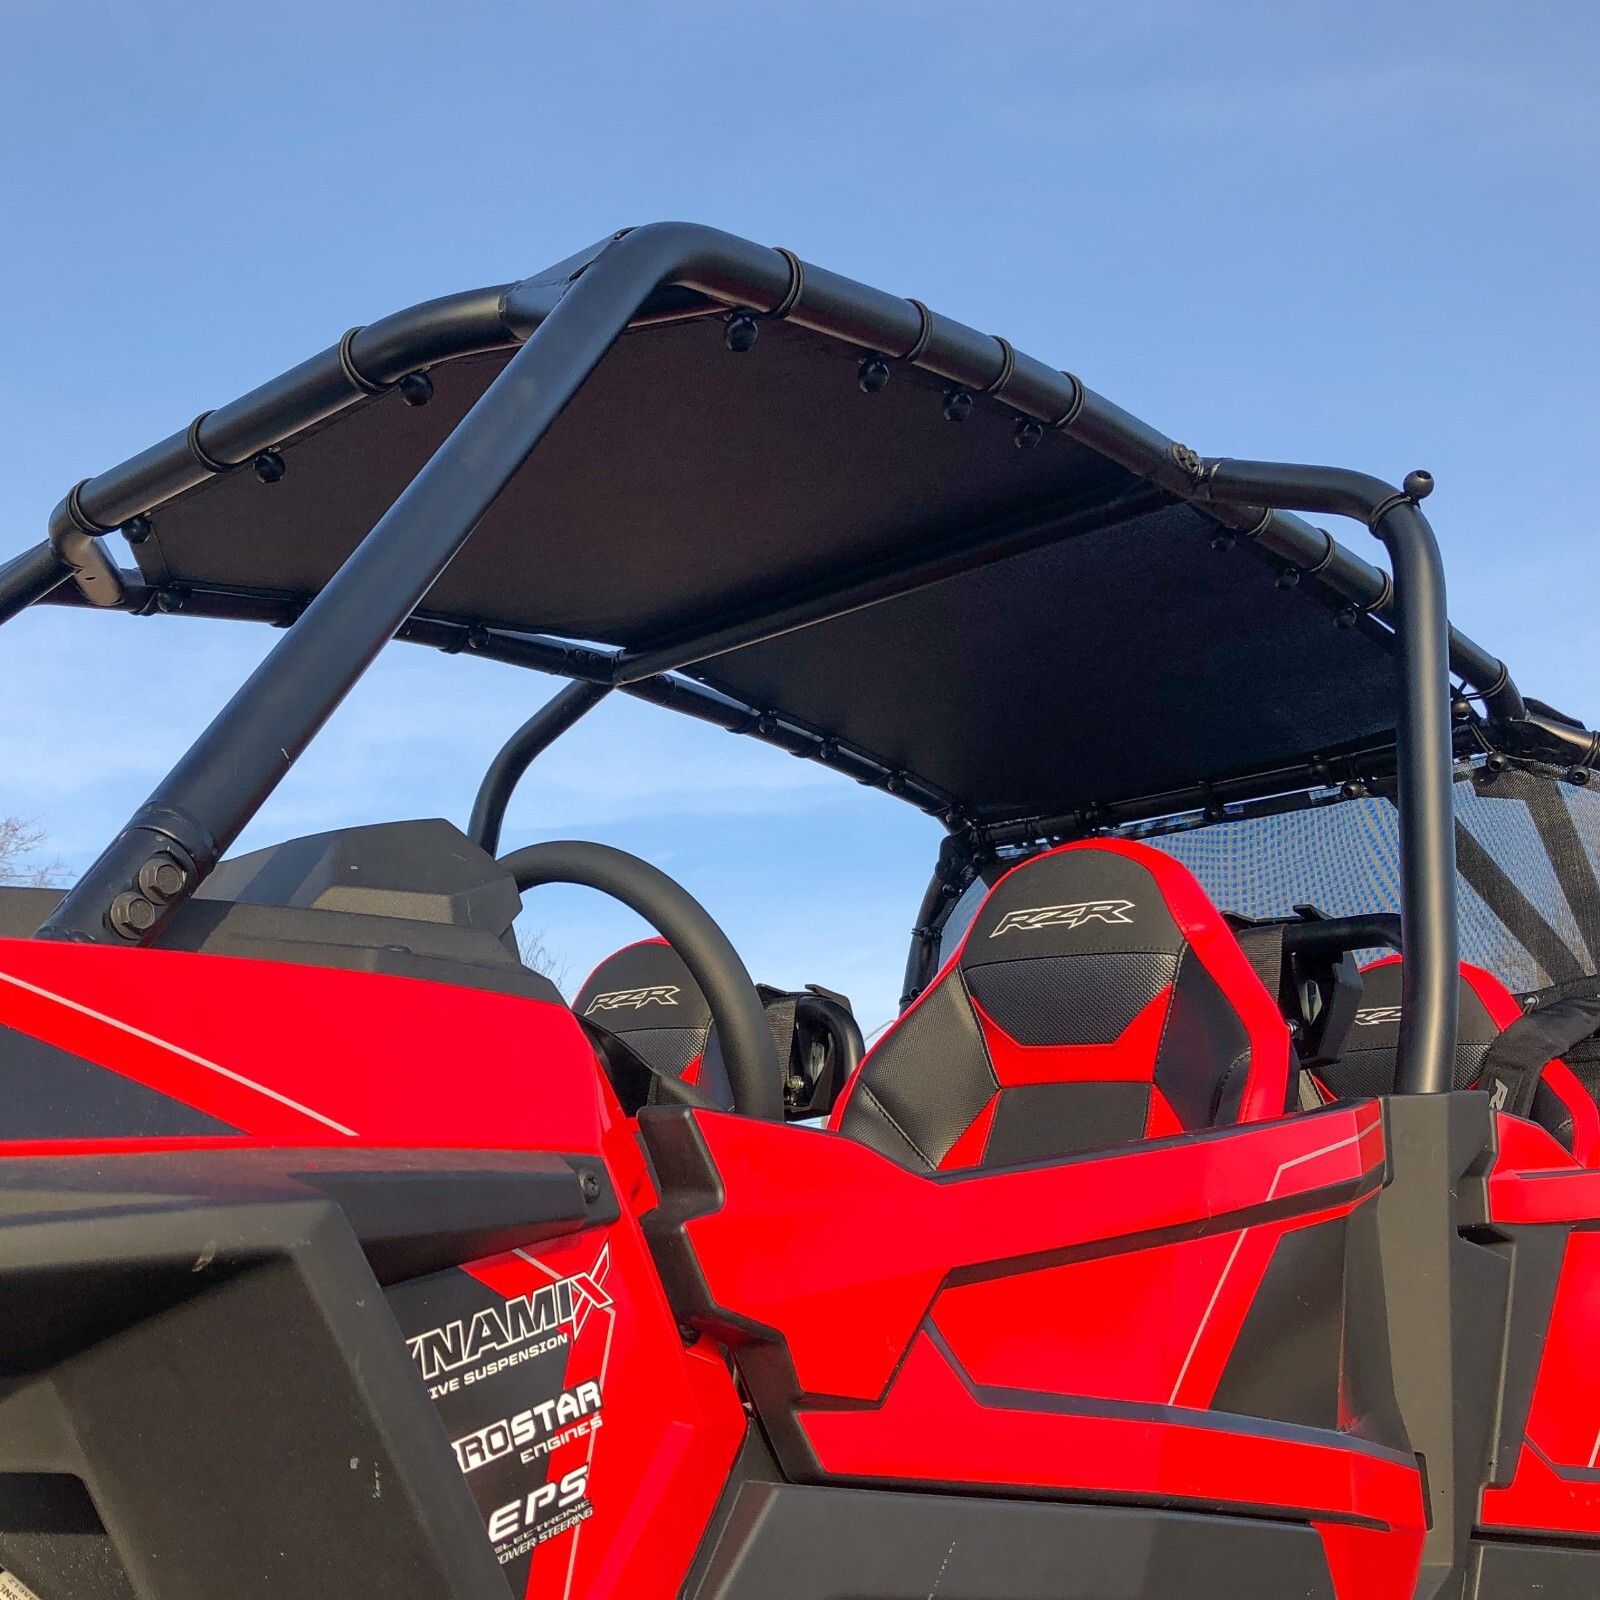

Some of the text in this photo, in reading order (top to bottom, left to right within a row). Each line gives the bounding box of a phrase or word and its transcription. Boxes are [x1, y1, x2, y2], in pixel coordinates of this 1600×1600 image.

[990, 900, 1136, 938] RZR
[583, 985, 681, 1017] RZR
[405, 1241, 614, 1380] NAMIX
[427, 1332, 568, 1400] IVE SUSPENSION
[451, 1381, 602, 1474] ROSTAR
[488, 1464, 590, 1543] EPS
[497, 1507, 593, 1564] OWER STEERING
